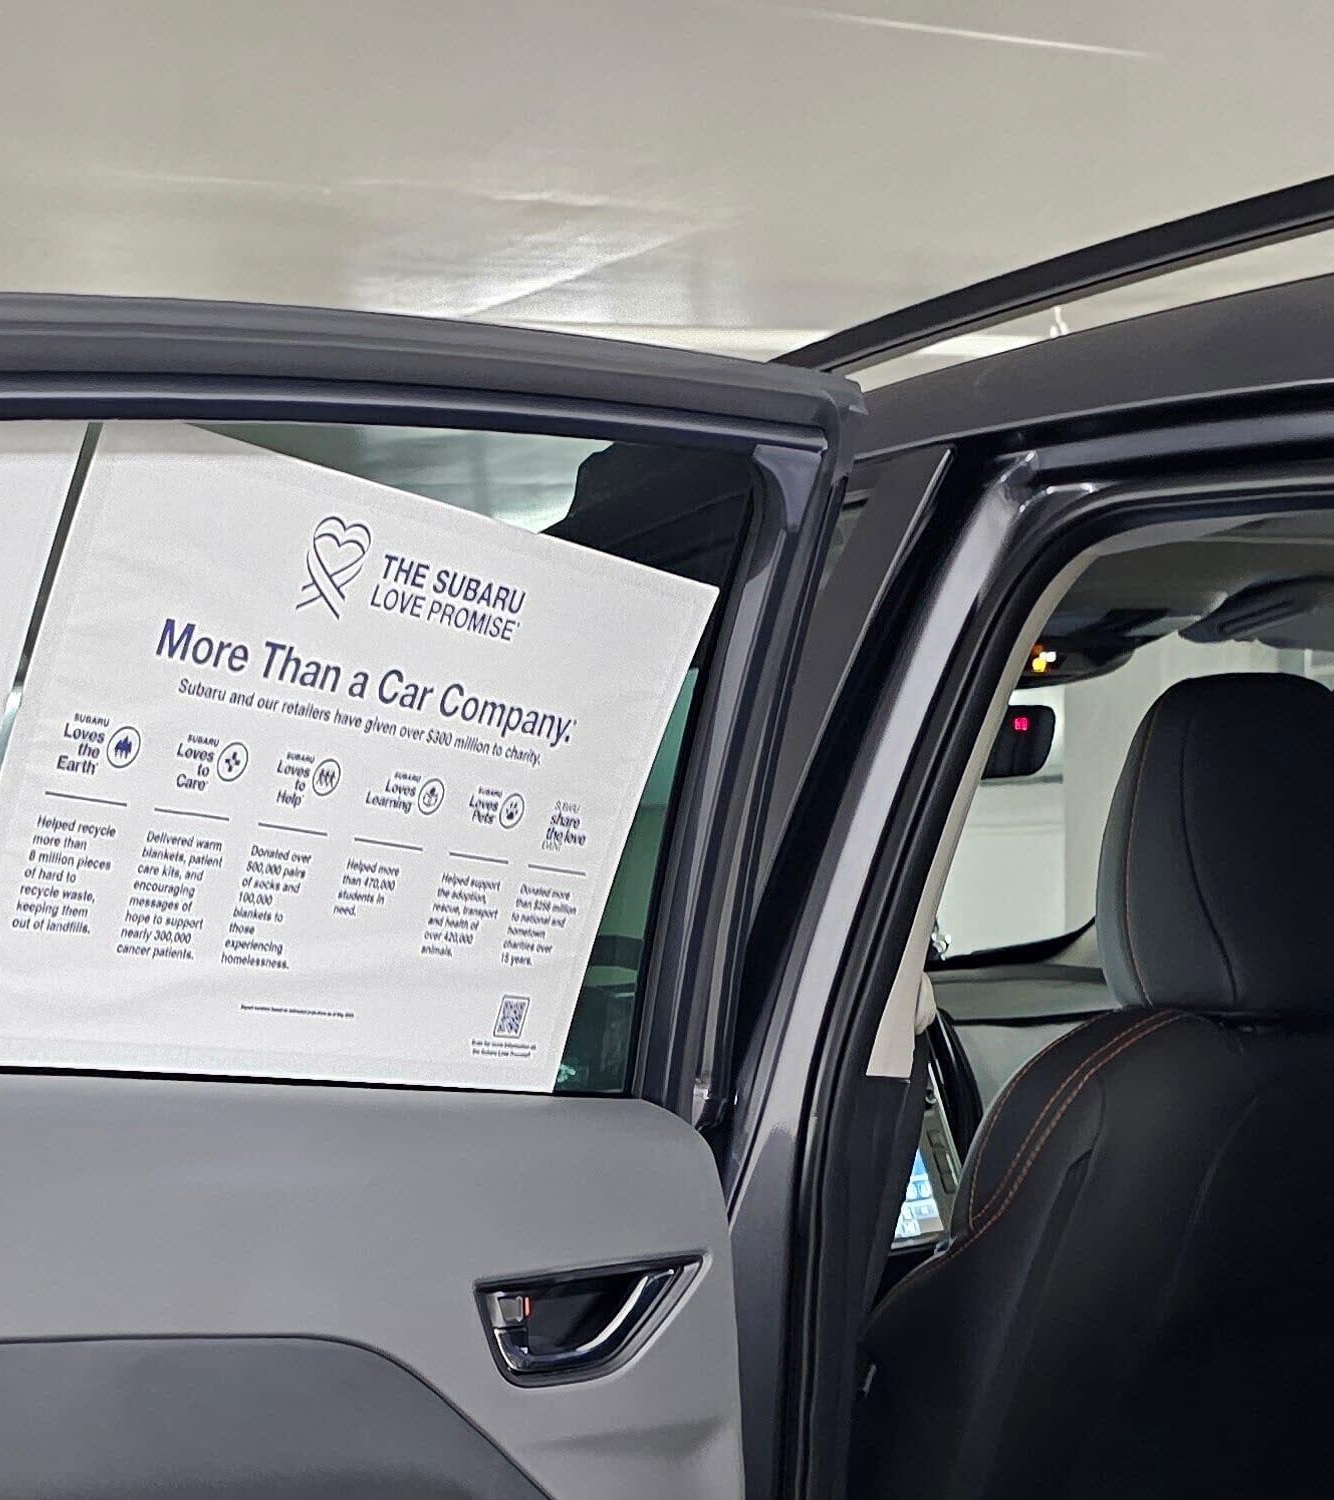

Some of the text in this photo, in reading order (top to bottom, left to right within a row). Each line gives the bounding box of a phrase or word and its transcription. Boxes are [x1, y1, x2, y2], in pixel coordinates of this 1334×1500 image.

[382, 554, 526, 614] THE SUBARU
[371, 585, 516, 641] LOVE PROMISE
[155, 618, 576, 747] More Than a Car Company.
[74, 713, 110, 727] SUBARU
[178, 678, 541, 768] Subaru and our retailers have given over $300 million to charity.
[64, 723, 105, 743] Loves
[187, 734, 219, 747] SUBARU
[78, 743, 100, 759] the
[177, 743, 214, 762] Loves
[287, 751, 315, 763] SUBARU
[57, 755, 96, 775] Earth
[197, 763, 210, 777] to
[277, 760, 311, 778] Loves
[176, 773, 206, 791] Care
[295, 779, 305, 792] to
[385, 779, 416, 797] Loves
[276, 791, 302, 808] Help
[366, 791, 412, 814] Learning
[469, 794, 499, 811] Loves
[472, 809, 494, 824] Pets
[550, 812, 580, 828] share
[37, 815, 116, 838] Helped recycle
[33, 835, 87, 850] more than
[147, 831, 222, 850] Delivered warm
[547, 828, 586, 846] the love
[29, 850, 111, 871] 8 million pieces
[142, 847, 223, 868] blankets, patient
[251, 845, 312, 864] Donated over
[24, 867, 76, 883] of hard to
[138, 864, 203, 881] care kits, and
[246, 862, 305, 879] 500,000 pairs
[347, 858, 399, 877] Helped more
[242, 877, 300, 894] of socks and
[342, 875, 361, 886] than
[441, 872, 501, 891] Helped support
[20, 884, 95, 904] recycle waste,
[134, 881, 195, 898] encouraging
[338, 891, 384, 904] students in
[437, 888, 450, 898] the
[520, 883, 570, 900] Donated more
[129, 897, 192, 913] messages of
[239, 892, 273, 906] 100,000
[516, 899, 531, 910] than
[552, 905, 577, 915] million
[17, 901, 88, 917] keeping them
[233, 907, 283, 922] blankets to
[333, 906, 356, 916] need.
[463, 906, 498, 920] transport
[12, 918, 90, 934] out of landfills.
[125, 911, 203, 930] hope to support
[428, 917, 479, 931] and health of
[511, 912, 566, 927] to national and
[121, 928, 191, 944] nearly 300,000
[229, 923, 255, 935] those
[424, 932, 441, 941] over
[507, 926, 545, 939] hometown
[117, 944, 194, 961] cancer patients.
[225, 938, 283, 955] experiencing
[503, 940, 552, 953] charities over
[221, 953, 289, 970] homelessness.
